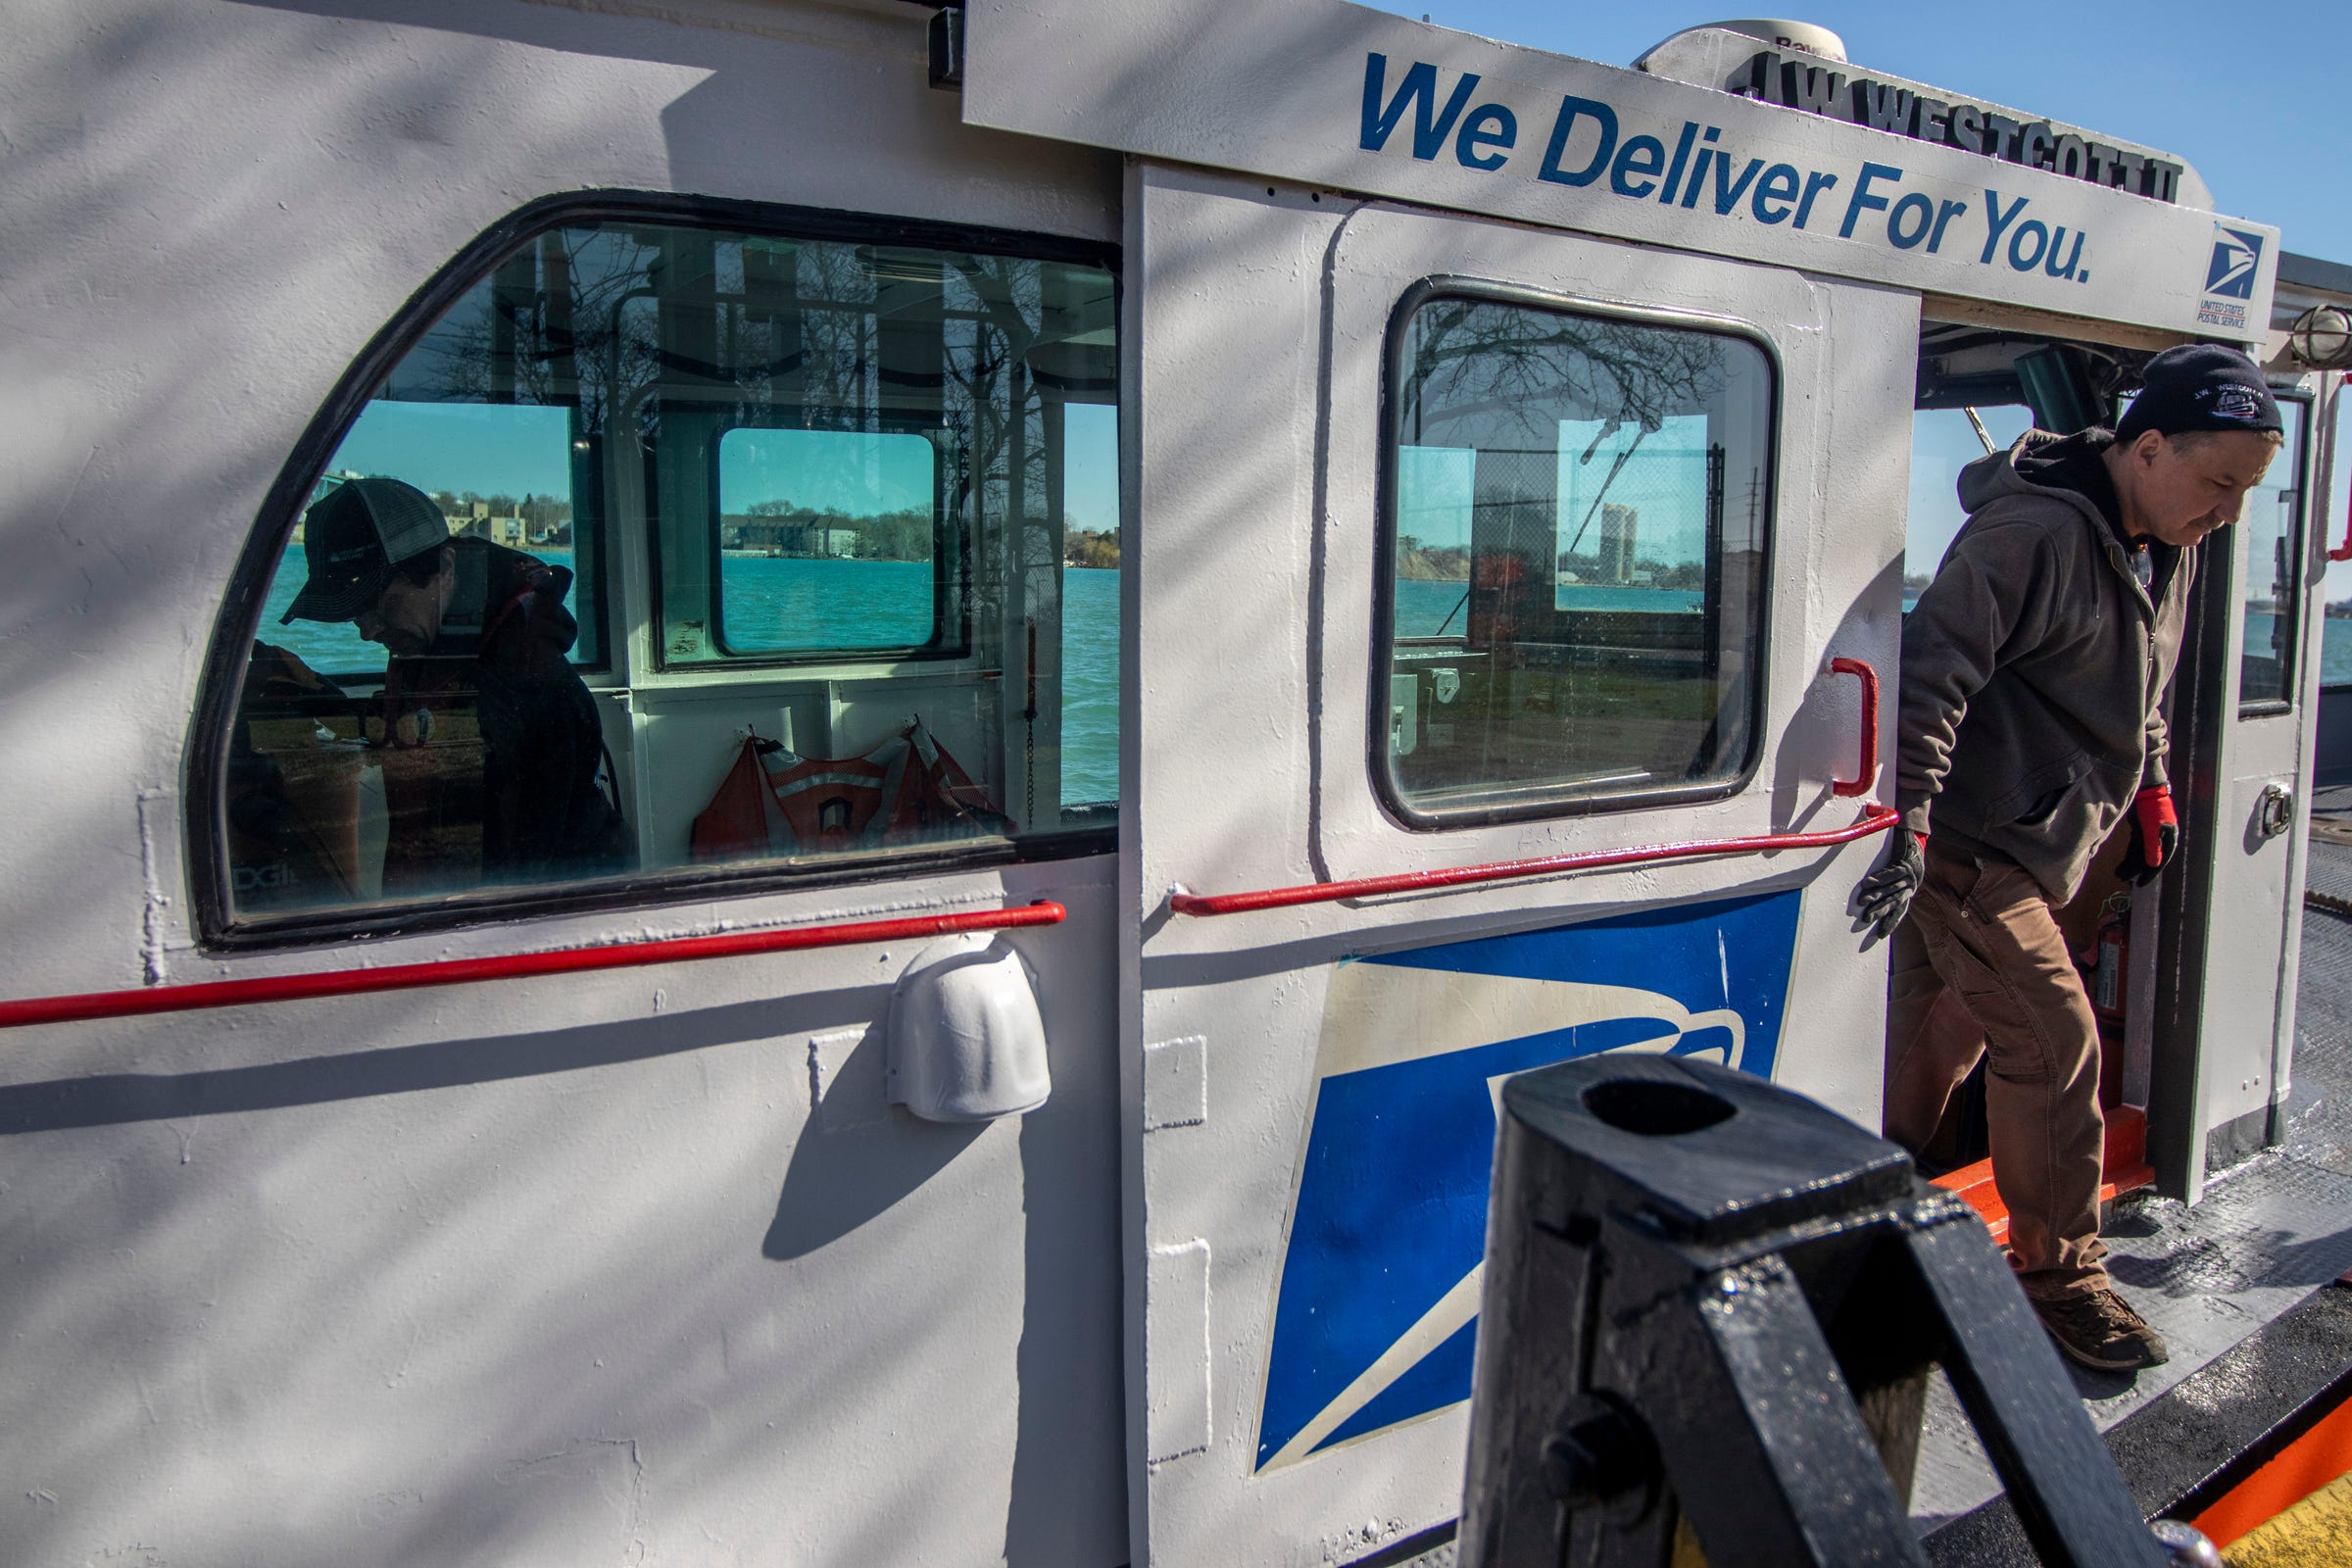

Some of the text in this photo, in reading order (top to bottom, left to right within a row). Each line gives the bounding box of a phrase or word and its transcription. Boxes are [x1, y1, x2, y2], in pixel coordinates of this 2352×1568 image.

[1360, 52, 2089, 283] We Deliver For You.
[1859, 77, 2145, 197] WESTCOTT
[2196, 312, 2245, 329] POSTAL SERVICE
[2199, 299, 2246, 317] UNITED STATES
